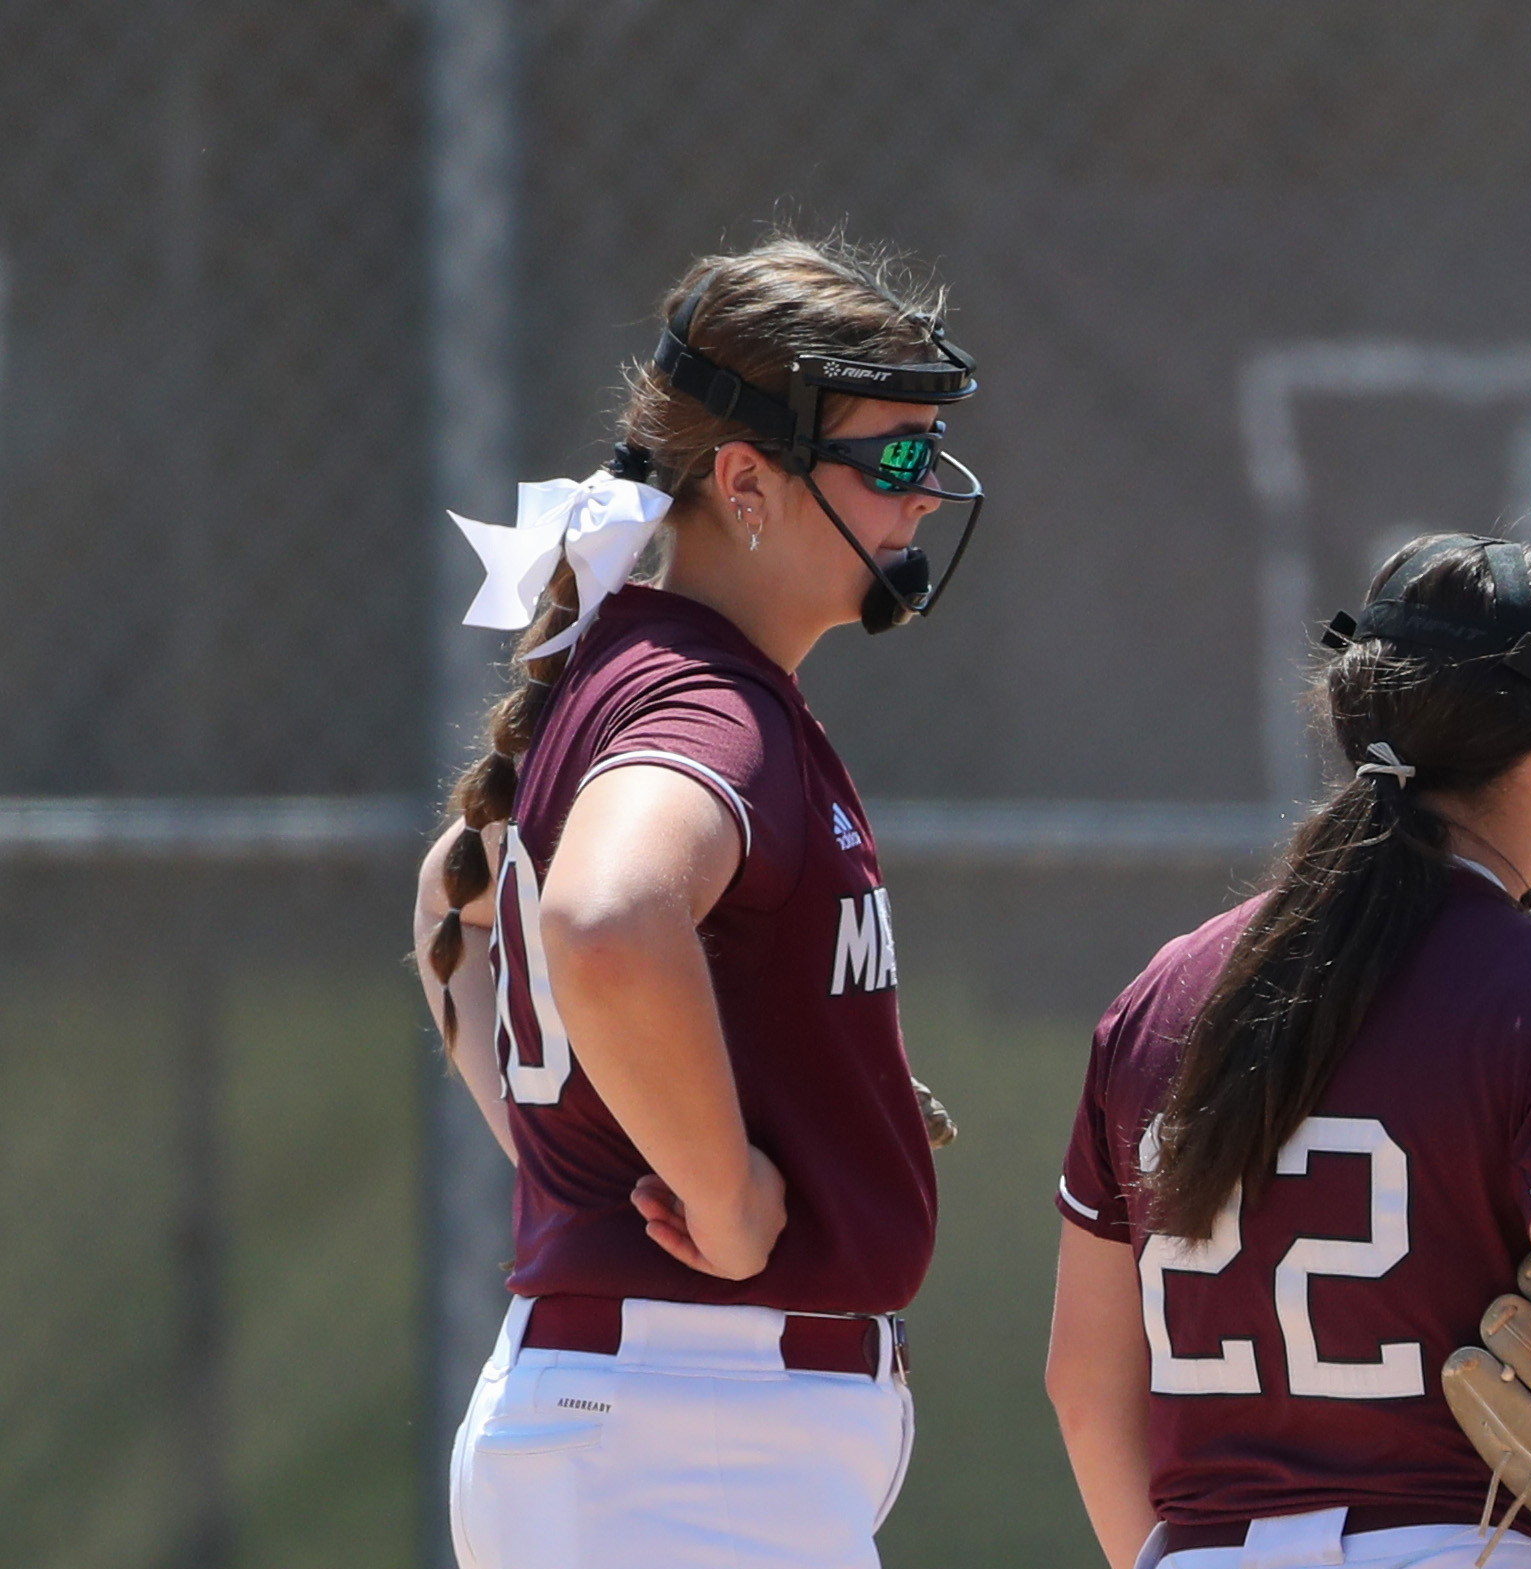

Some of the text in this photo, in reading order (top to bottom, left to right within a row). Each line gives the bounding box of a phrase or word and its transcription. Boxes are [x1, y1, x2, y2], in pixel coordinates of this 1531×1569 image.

[841, 366, 892, 381] RIP-IT
[489, 825, 572, 1105] 0
[1138, 1115, 1426, 1400] 22
[556, 1397, 611, 1414] AEROREADY
